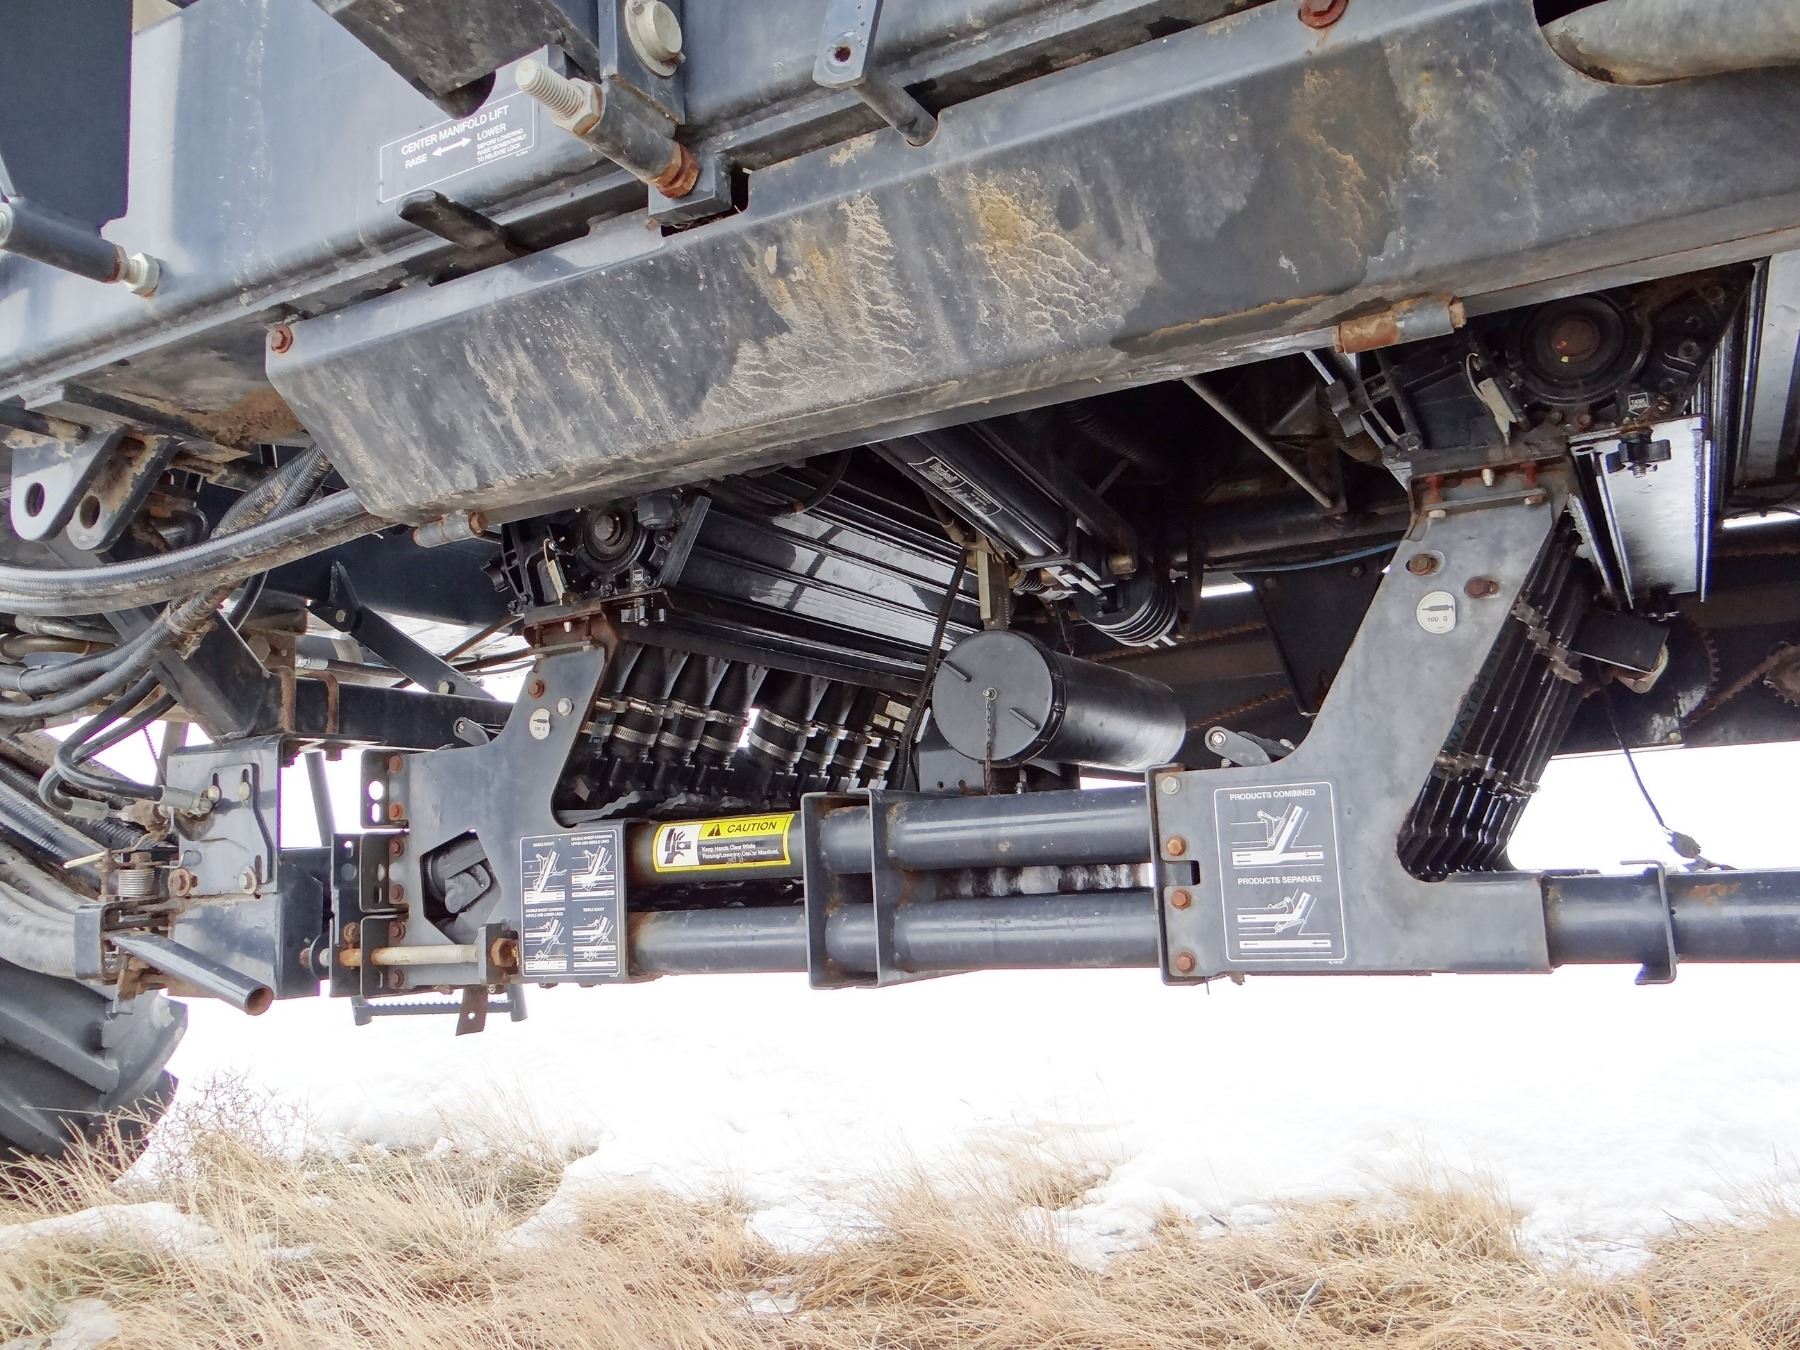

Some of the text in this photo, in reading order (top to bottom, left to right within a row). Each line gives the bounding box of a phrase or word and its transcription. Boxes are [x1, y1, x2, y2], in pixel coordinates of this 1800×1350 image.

[401, 105, 509, 156] CENTER MANIFOLD LIFT
[477, 123, 506, 141] LOWER
[405, 154, 428, 169] RAISE
[1229, 788, 1316, 801] PRODUCTS COMBINED
[727, 821, 777, 834] CAUTION
[1238, 875, 1322, 885] PRODUCTS SEPARATE
